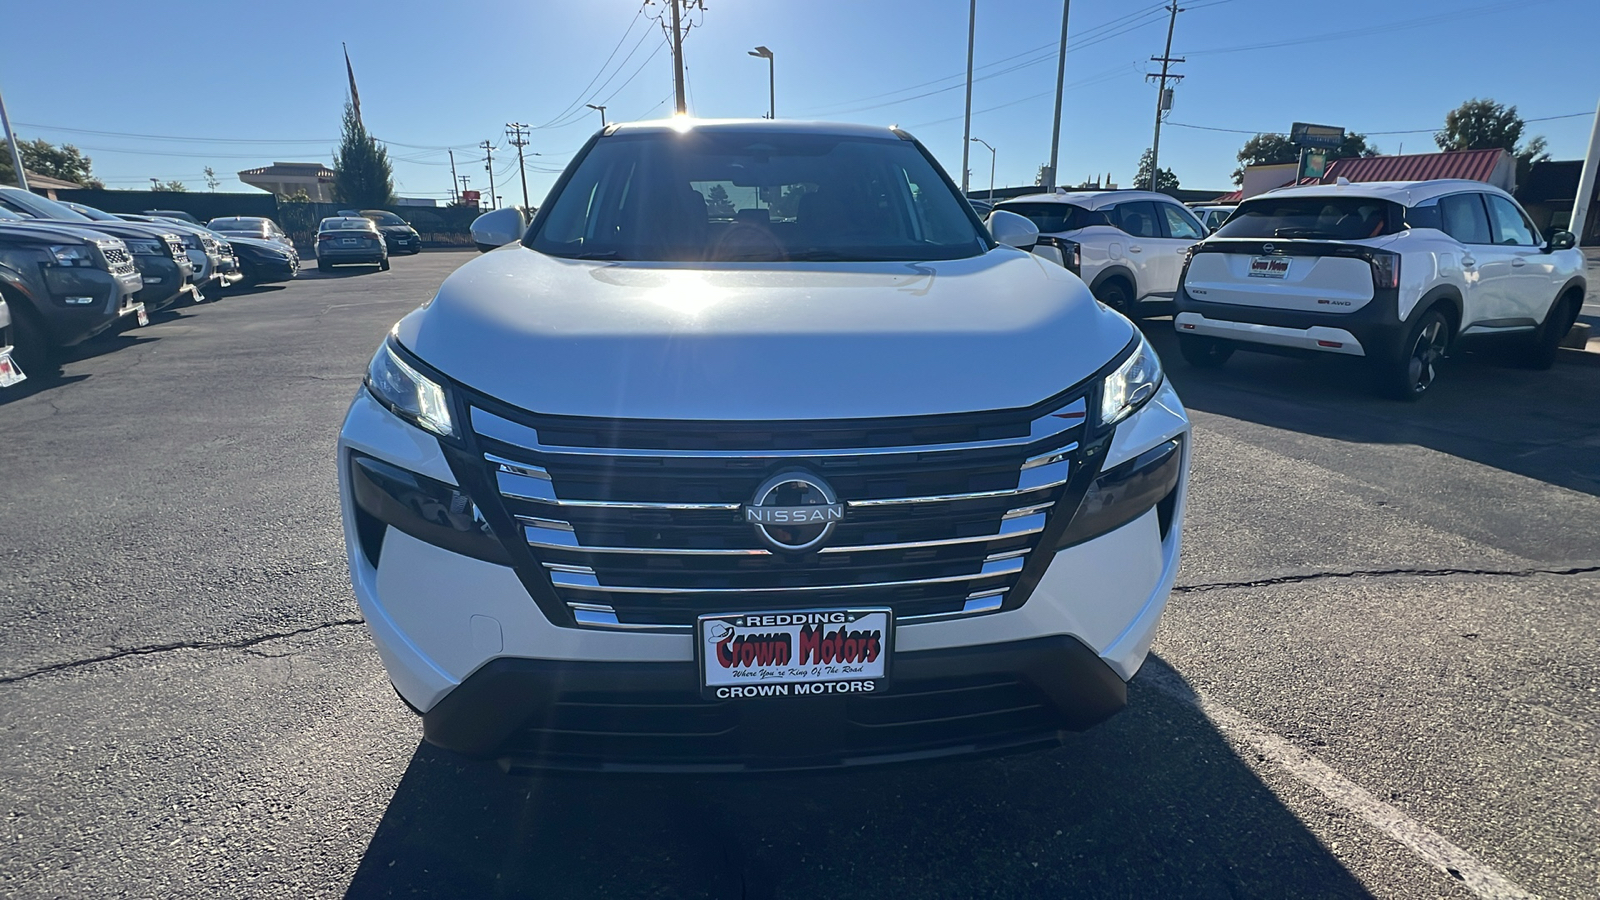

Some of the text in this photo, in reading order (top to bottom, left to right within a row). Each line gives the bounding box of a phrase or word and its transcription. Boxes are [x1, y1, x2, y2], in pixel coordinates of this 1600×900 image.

[747, 506, 842, 522] NISSAN
[746, 613, 846, 626] REDDING
[716, 623, 881, 668] Crown Motors
[732, 665, 864, 679] Where You're King Of The Road
[716, 680, 875, 699] CROWN MOTORS
